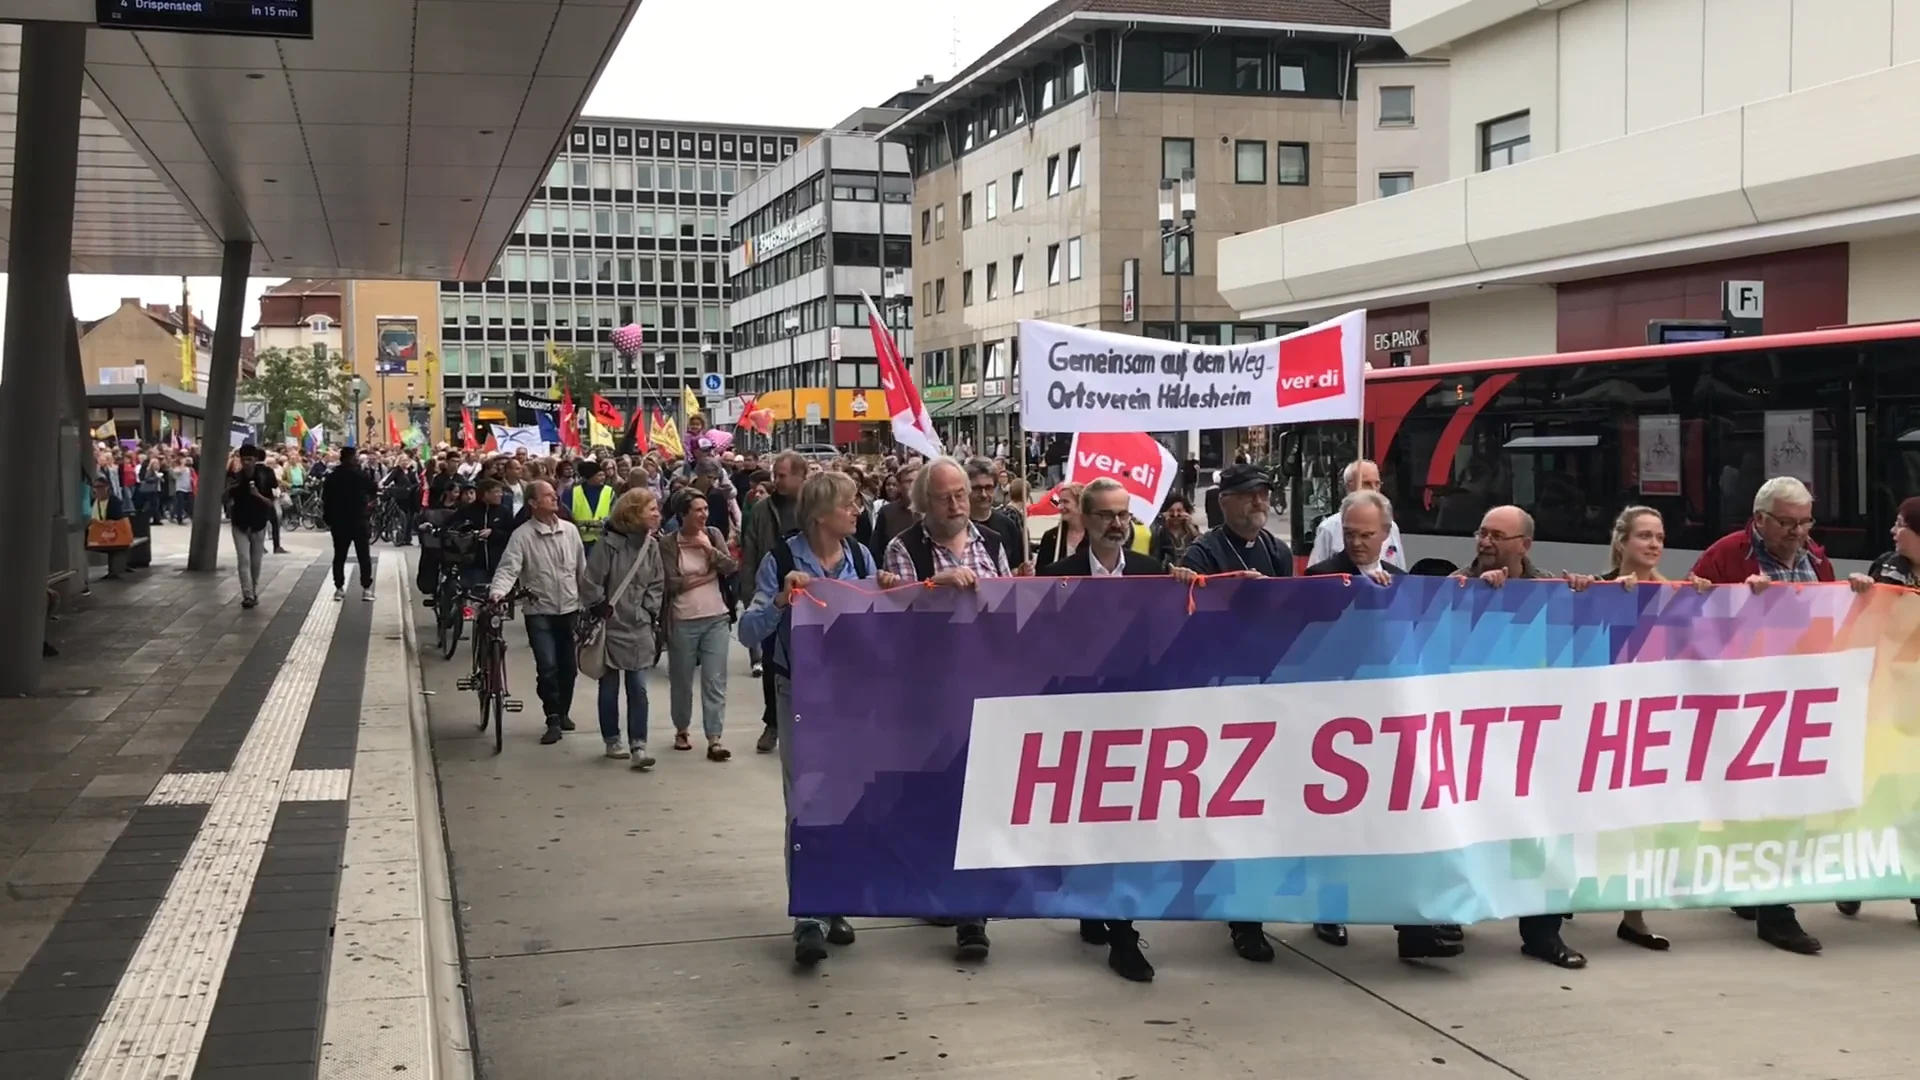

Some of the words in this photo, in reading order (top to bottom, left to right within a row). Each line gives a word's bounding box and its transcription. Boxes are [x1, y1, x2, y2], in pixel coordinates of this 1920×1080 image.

[135, 0, 202, 12] Drispenstedt
[251, 5, 261, 15] in
[264, 6, 276, 16] 15
[278, 8, 298, 17] min
[1374, 333, 1390, 351] EIS
[1392, 329, 1420, 348] PARK
[1048, 341, 1155, 374] Gemeinsam
[1161, 349, 1189, 381] auf
[1193, 349, 1224, 373] dem
[1048, 381, 1151, 410] Ortsverein
[1158, 383, 1251, 409] Hildesheim
[1281, 369, 1339, 391] ver.di
[1078, 451, 1156, 489] ver.di
[1010, 721, 1277, 825] HERZ
[1302, 704, 1563, 815] STATT
[1577, 687, 1839, 793] HETZE
[1626, 827, 1902, 902] HILDESHEIM
